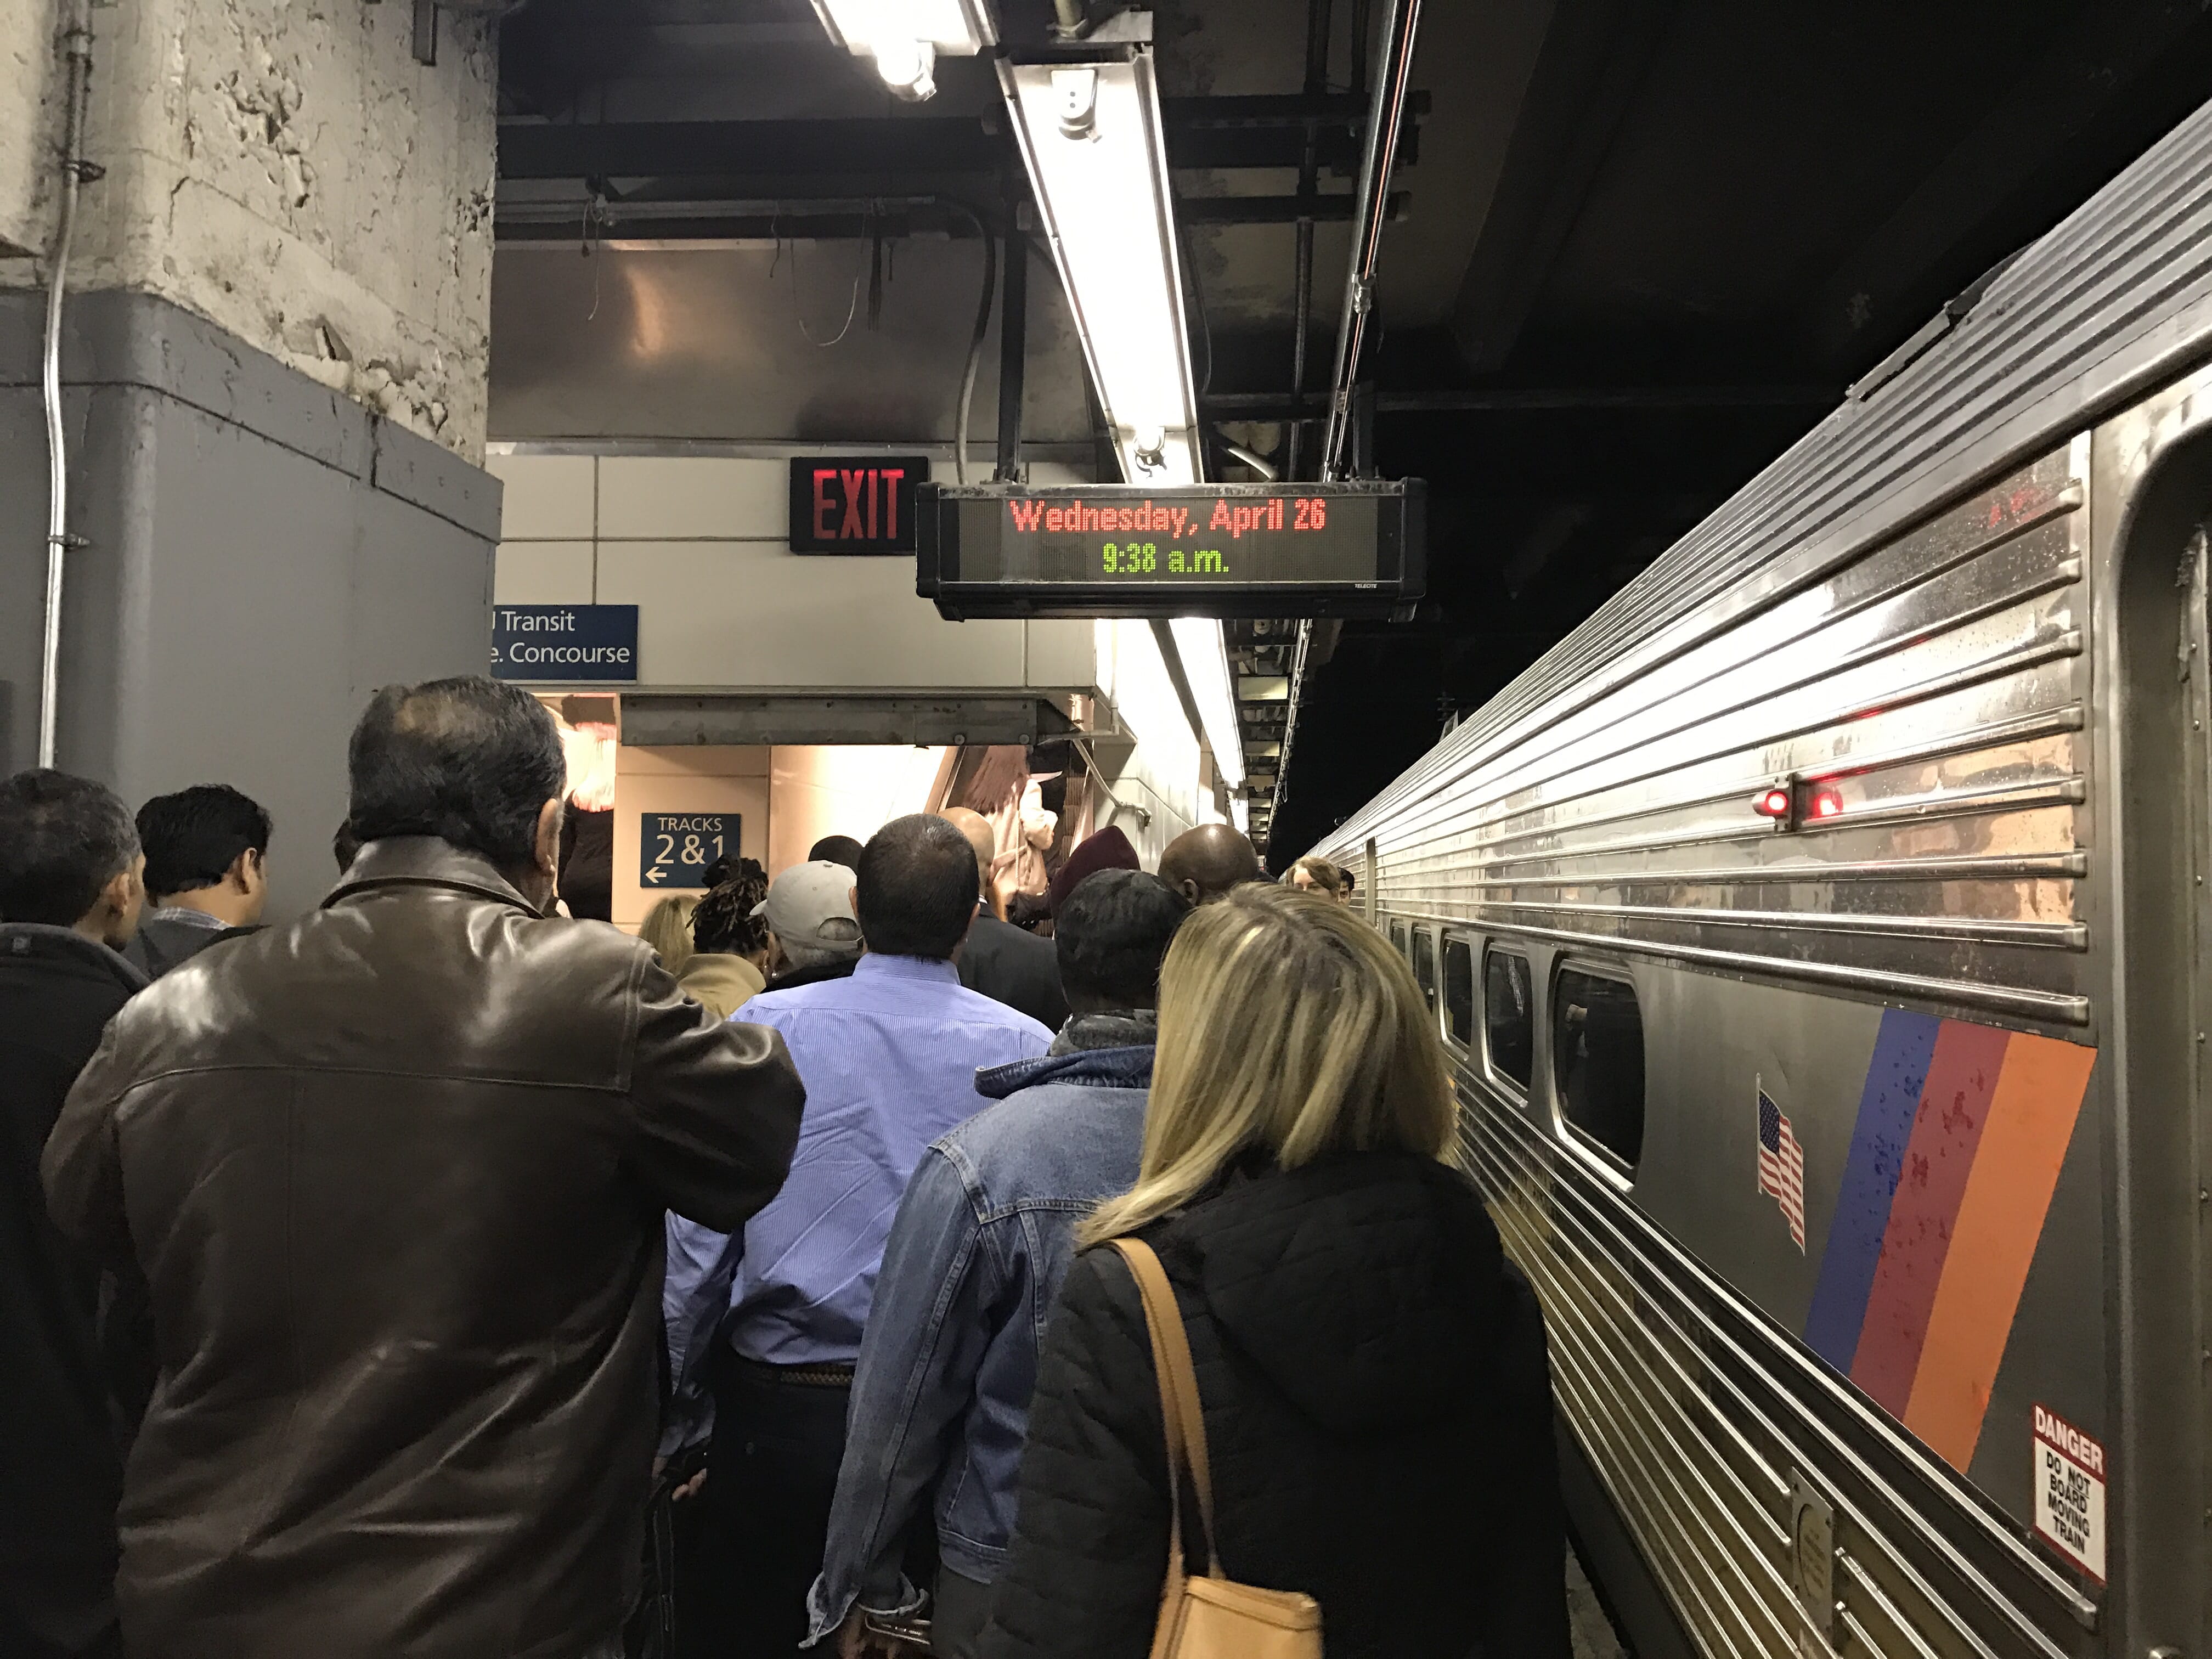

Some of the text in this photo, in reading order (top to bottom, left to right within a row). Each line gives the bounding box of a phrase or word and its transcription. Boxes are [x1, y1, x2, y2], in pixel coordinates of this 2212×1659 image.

[813, 469, 904, 539] EXIT
[1009, 498, 1325, 539] Wednesday, April 26
[1102, 543, 1229, 573] 9:38 a.m.
[501, 610, 575, 631] Transit
[510, 642, 630, 663] Concourse
[658, 817, 723, 831] TRACKS
[2035, 1405, 2103, 1476] DANGER
[2046, 1451, 2091, 1496] DO NOT
[2050, 1472, 2087, 1514] BOARD
[2048, 1491, 2090, 1538] MOVING
[2053, 1515, 2085, 1555] TRAIN
